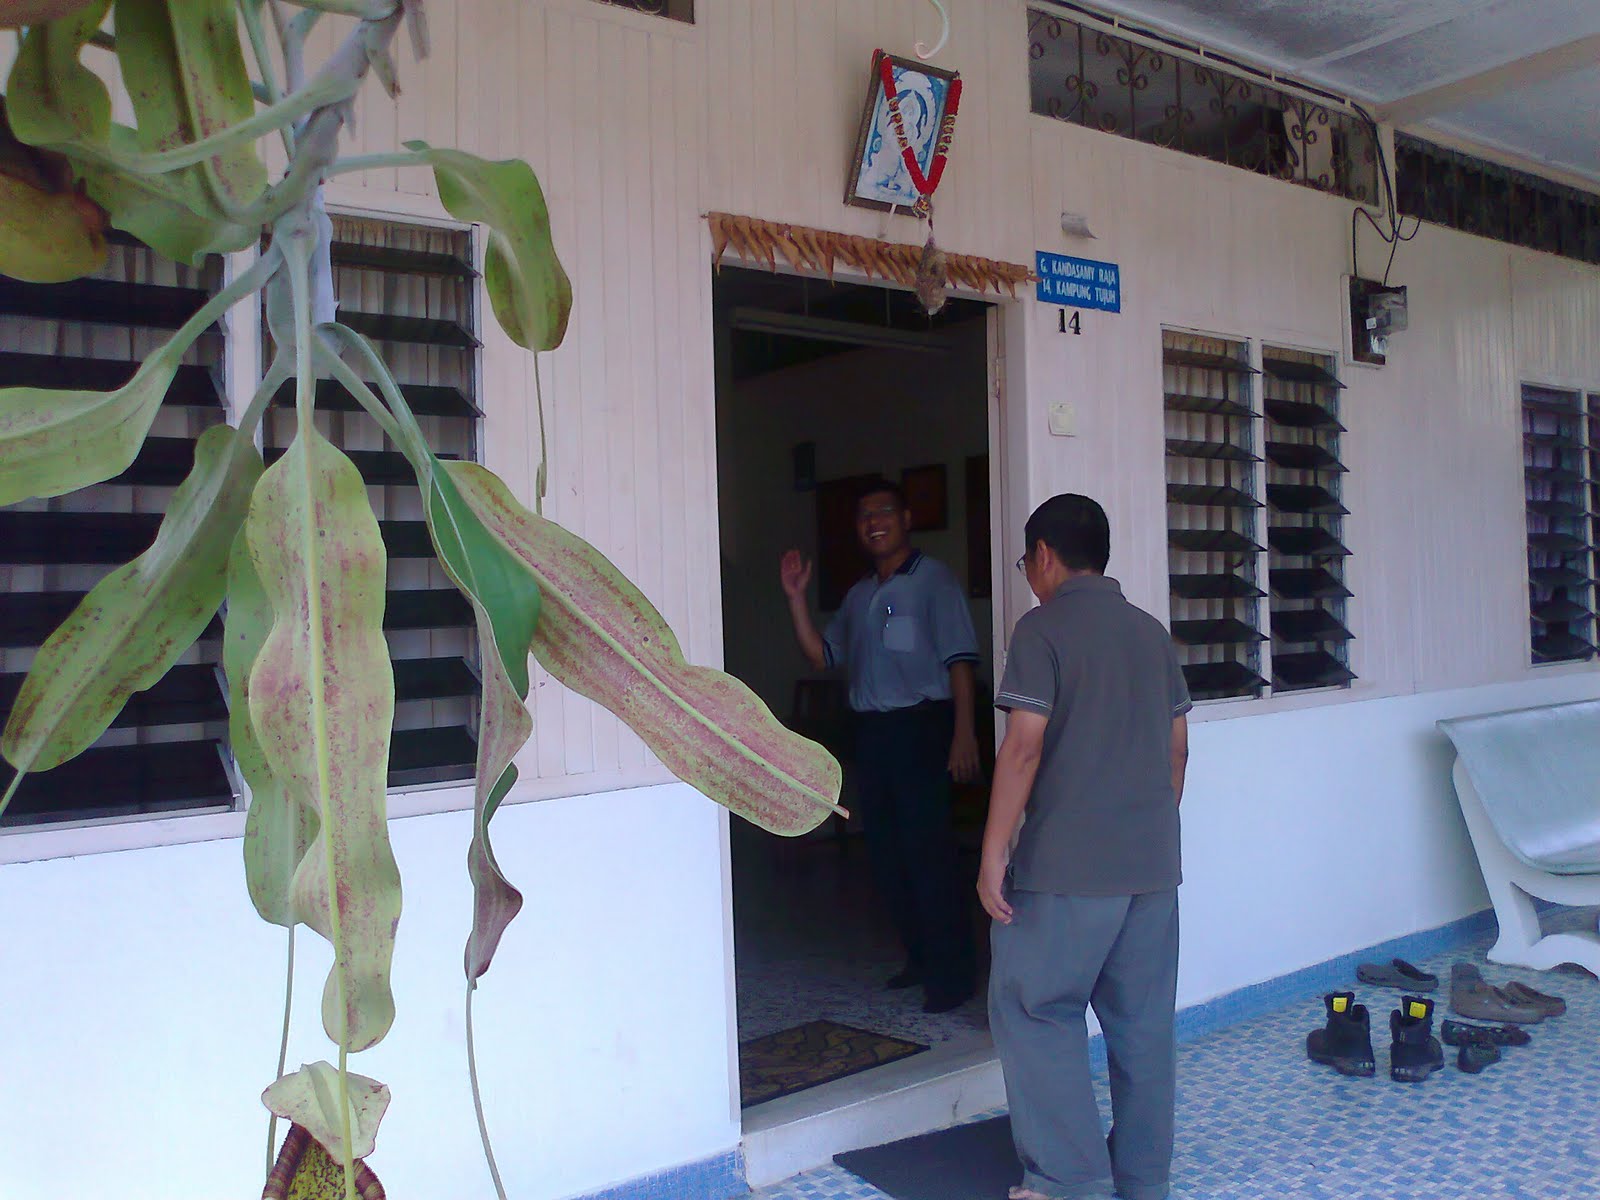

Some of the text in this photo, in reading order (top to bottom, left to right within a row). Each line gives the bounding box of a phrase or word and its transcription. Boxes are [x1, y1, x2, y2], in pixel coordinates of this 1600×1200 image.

[1052, 260, 1095, 280] KANDASAMY
[1098, 268, 1116, 287] RAJA
[1056, 281, 1091, 300] KAMPUNG
[1095, 287, 1116, 305] TUJUH
[1058, 308, 1081, 335] 14
